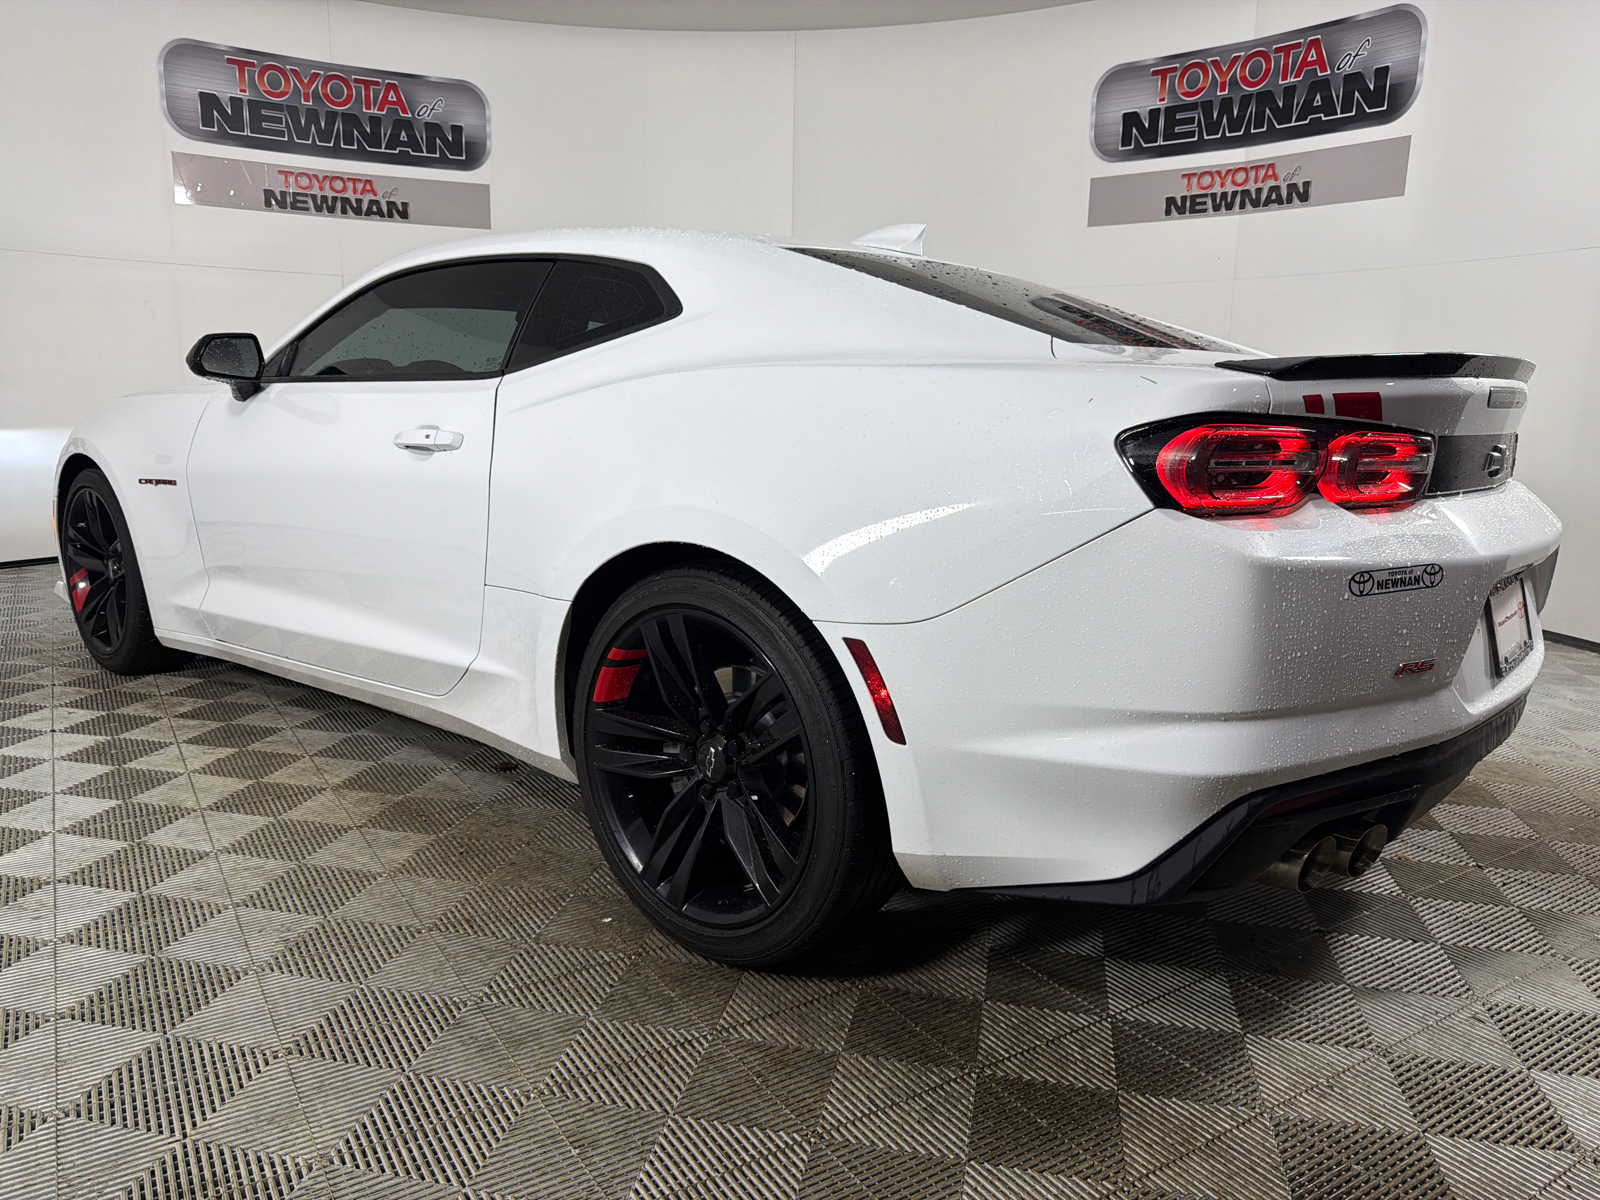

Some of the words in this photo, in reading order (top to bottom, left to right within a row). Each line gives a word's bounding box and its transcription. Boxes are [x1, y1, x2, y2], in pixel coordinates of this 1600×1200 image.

[1151, 35, 1331, 103] TOYOTA
[1335, 37, 1372, 73] of
[226, 56, 411, 117] TOYOTA
[415, 97, 444, 119] of
[1119, 64, 1391, 150] NEWNAN
[198, 90, 466, 160] NEWNAN
[277, 169, 378, 197] TOYOTA
[382, 187, 398, 199] of
[1181, 162, 1279, 192] TOYOTA
[1283, 165, 1302, 182] of
[263, 188, 410, 220] NEWNAN
[1164, 180, 1312, 217] NEWNAN
[1376, 575, 1421, 590] NEWNAN
[1393, 658, 1437, 677] RS
